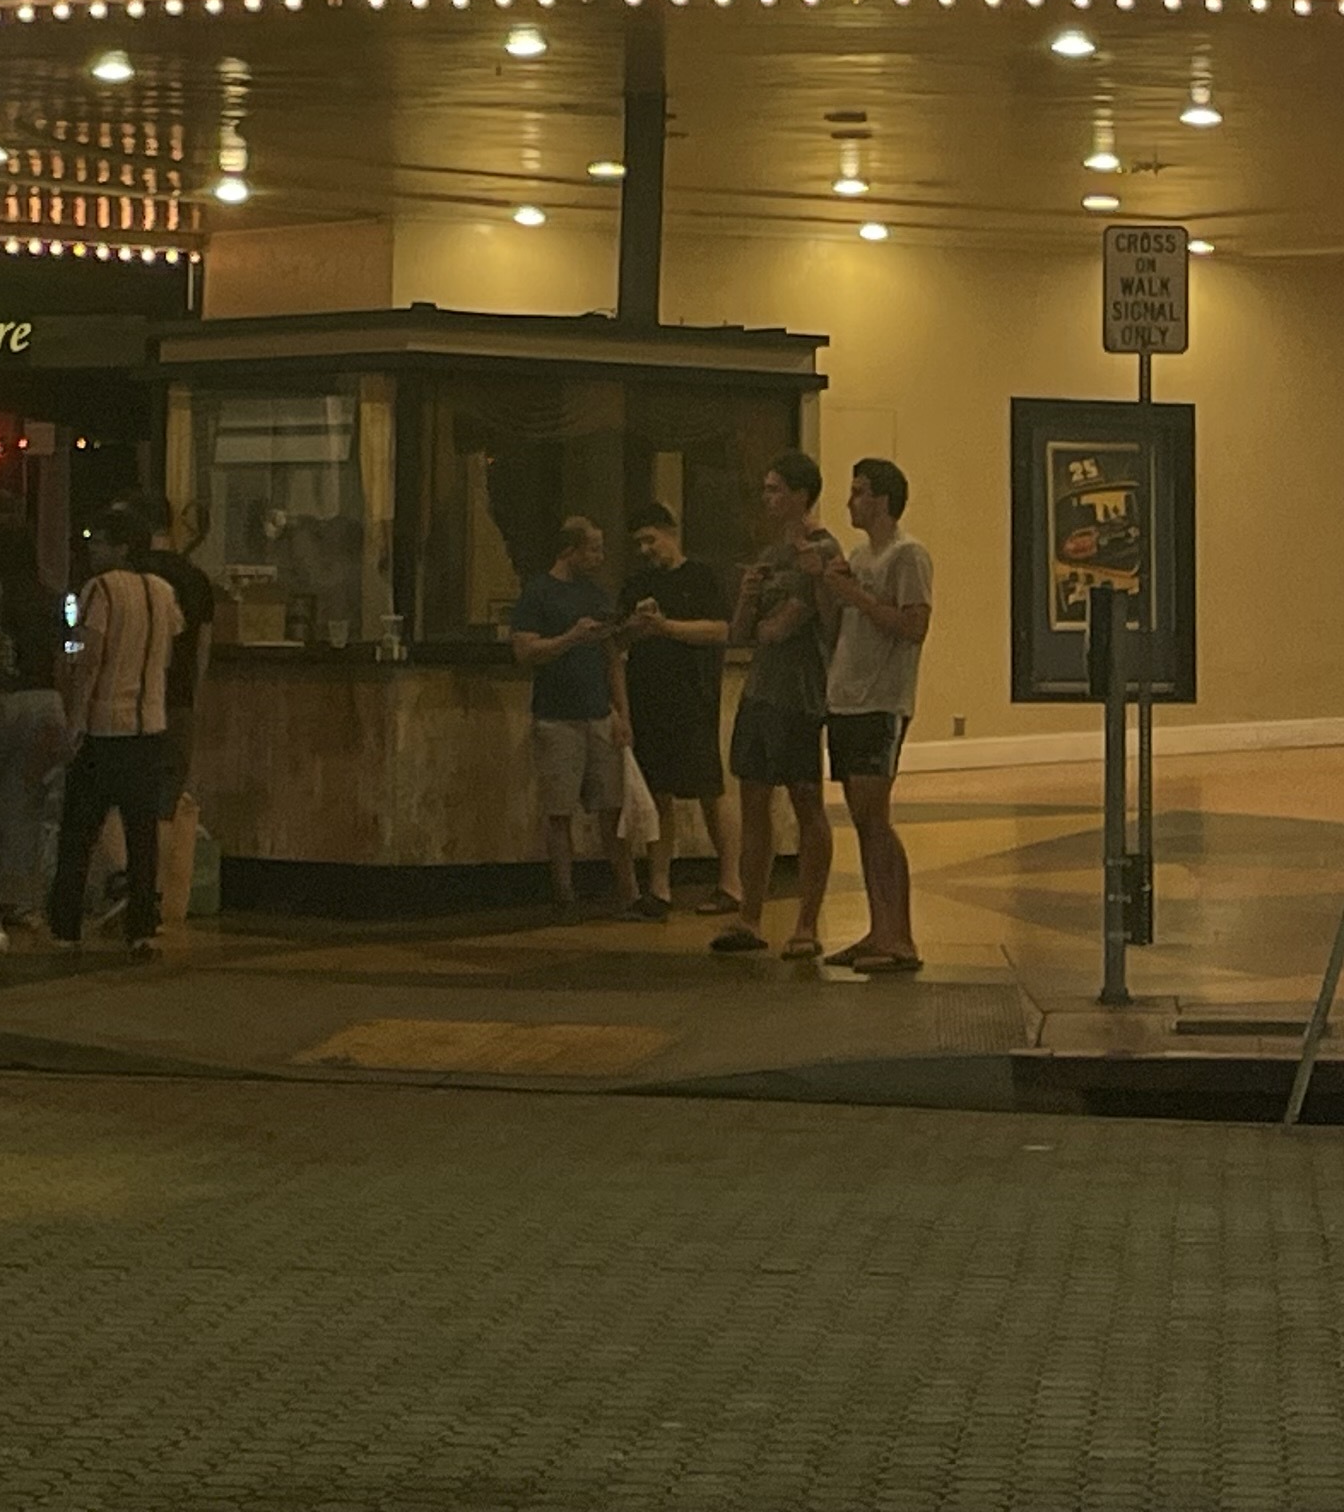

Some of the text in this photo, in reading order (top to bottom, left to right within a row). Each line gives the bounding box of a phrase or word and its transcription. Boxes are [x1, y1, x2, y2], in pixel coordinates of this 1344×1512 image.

[1116, 232, 1176, 254] CROSS
[1136, 257, 1156, 273] ON
[1119, 276, 1171, 297] WALK
[1112, 300, 1180, 322] SIGNAL
[1120, 324, 1169, 347] ONLY
